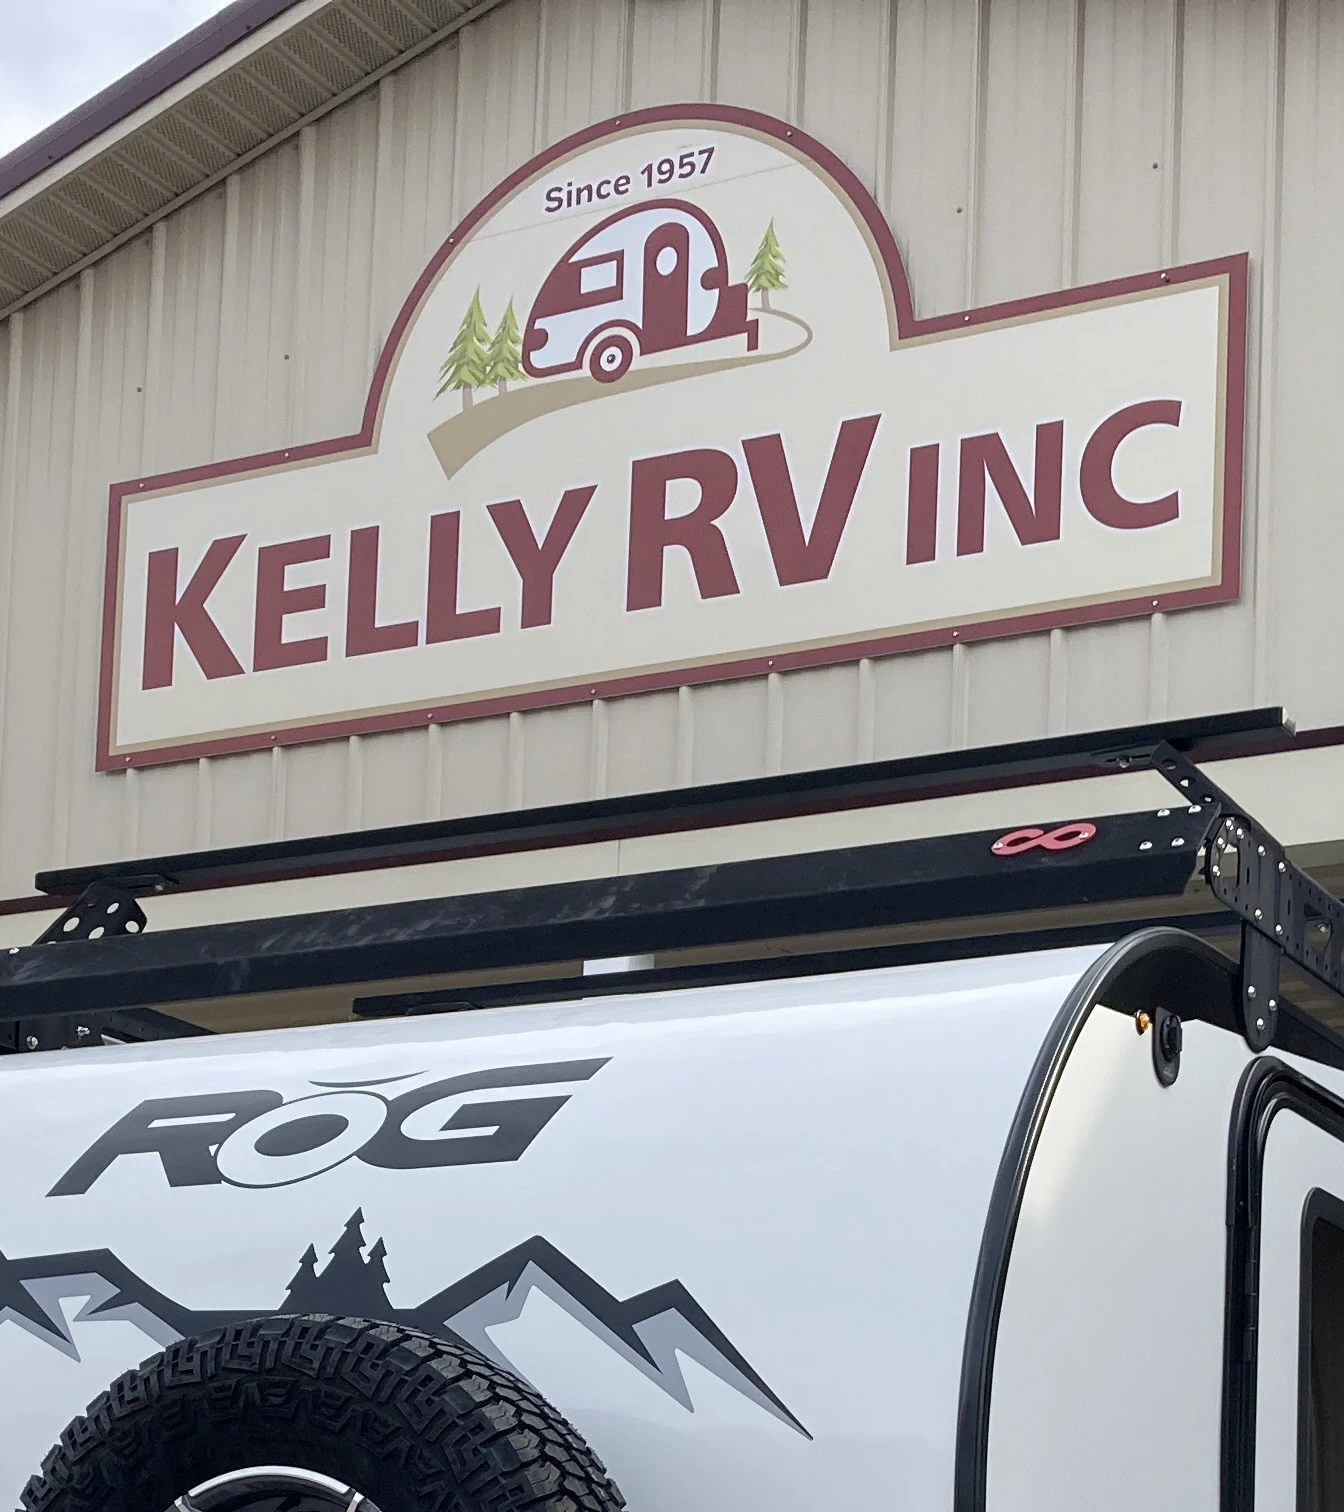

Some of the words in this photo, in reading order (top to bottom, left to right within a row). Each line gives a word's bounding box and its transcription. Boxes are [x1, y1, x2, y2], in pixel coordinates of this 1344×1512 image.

[544, 174, 631, 213] Since
[640, 146, 715, 188] 1957
[141, 484, 598, 690] KELLY
[625, 413, 882, 612] RV
[905, 399, 1183, 565] INC
